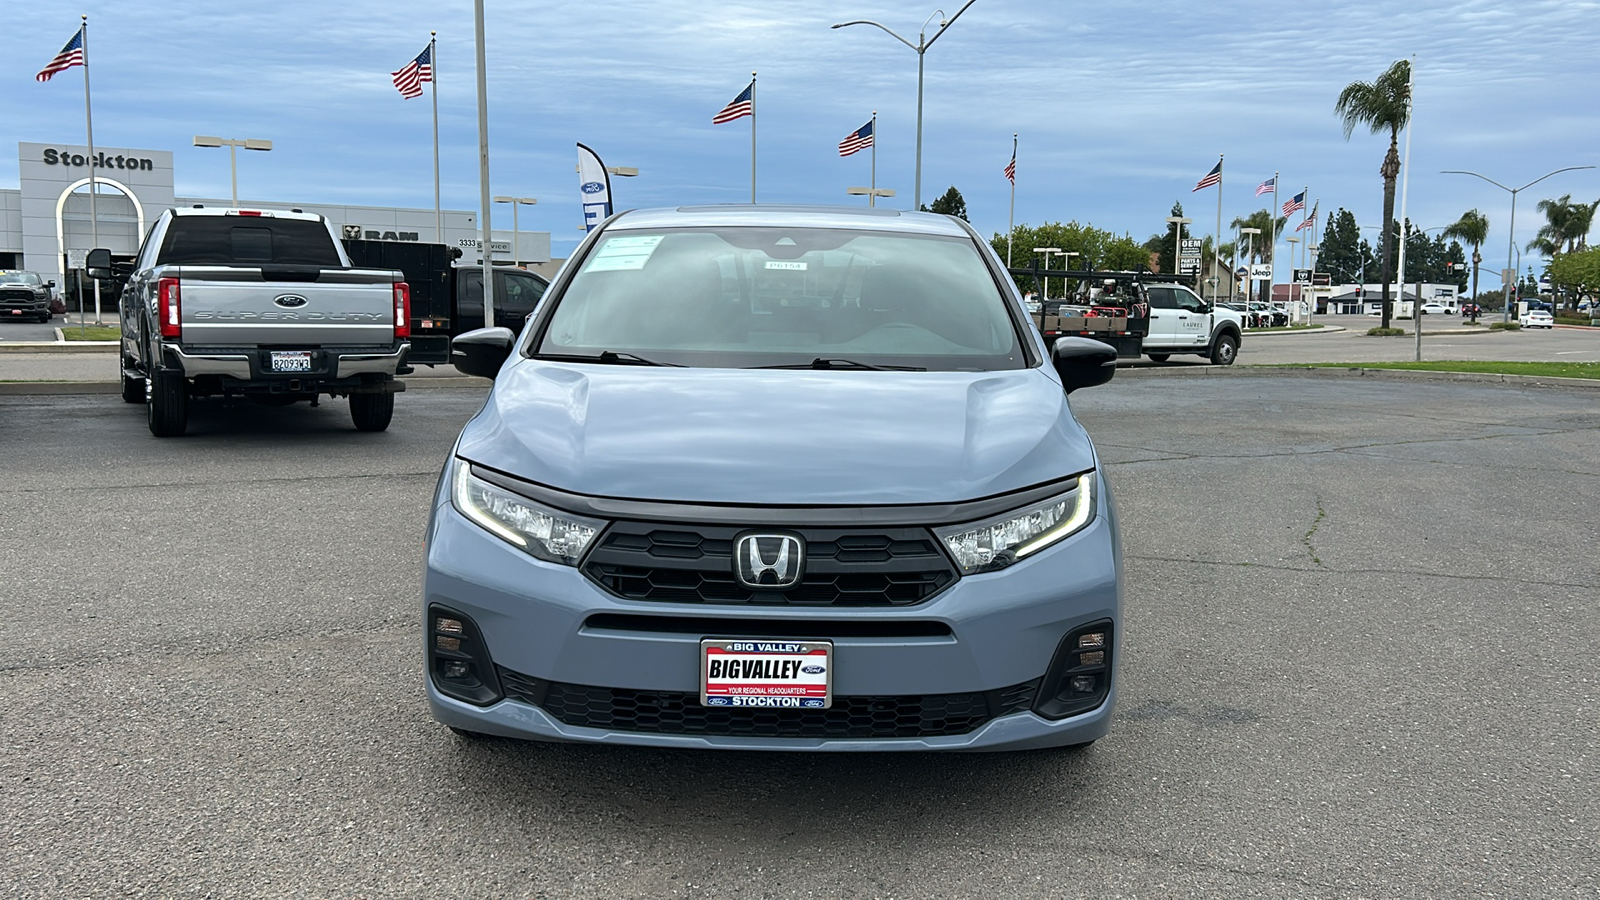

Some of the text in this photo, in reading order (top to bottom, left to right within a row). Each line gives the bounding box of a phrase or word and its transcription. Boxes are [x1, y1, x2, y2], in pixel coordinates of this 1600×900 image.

[43, 148, 153, 171] Stockton
[365, 230, 418, 241] RAM
[459, 239, 476, 247] 3333
[477, 242, 507, 250] Svice
[1181, 240, 1201, 248] OEM
[1252, 269, 1271, 277] Jeep
[194, 311, 383, 321] SUPER DUTY
[733, 643, 800, 653] BIG VALLEY
[709, 659, 802, 679] BIGVALLEY
[743, 687, 767, 695] REGIONAL
[767, 687, 806, 695] HEADQUARTERS
[732, 696, 800, 707] STOCKTON
